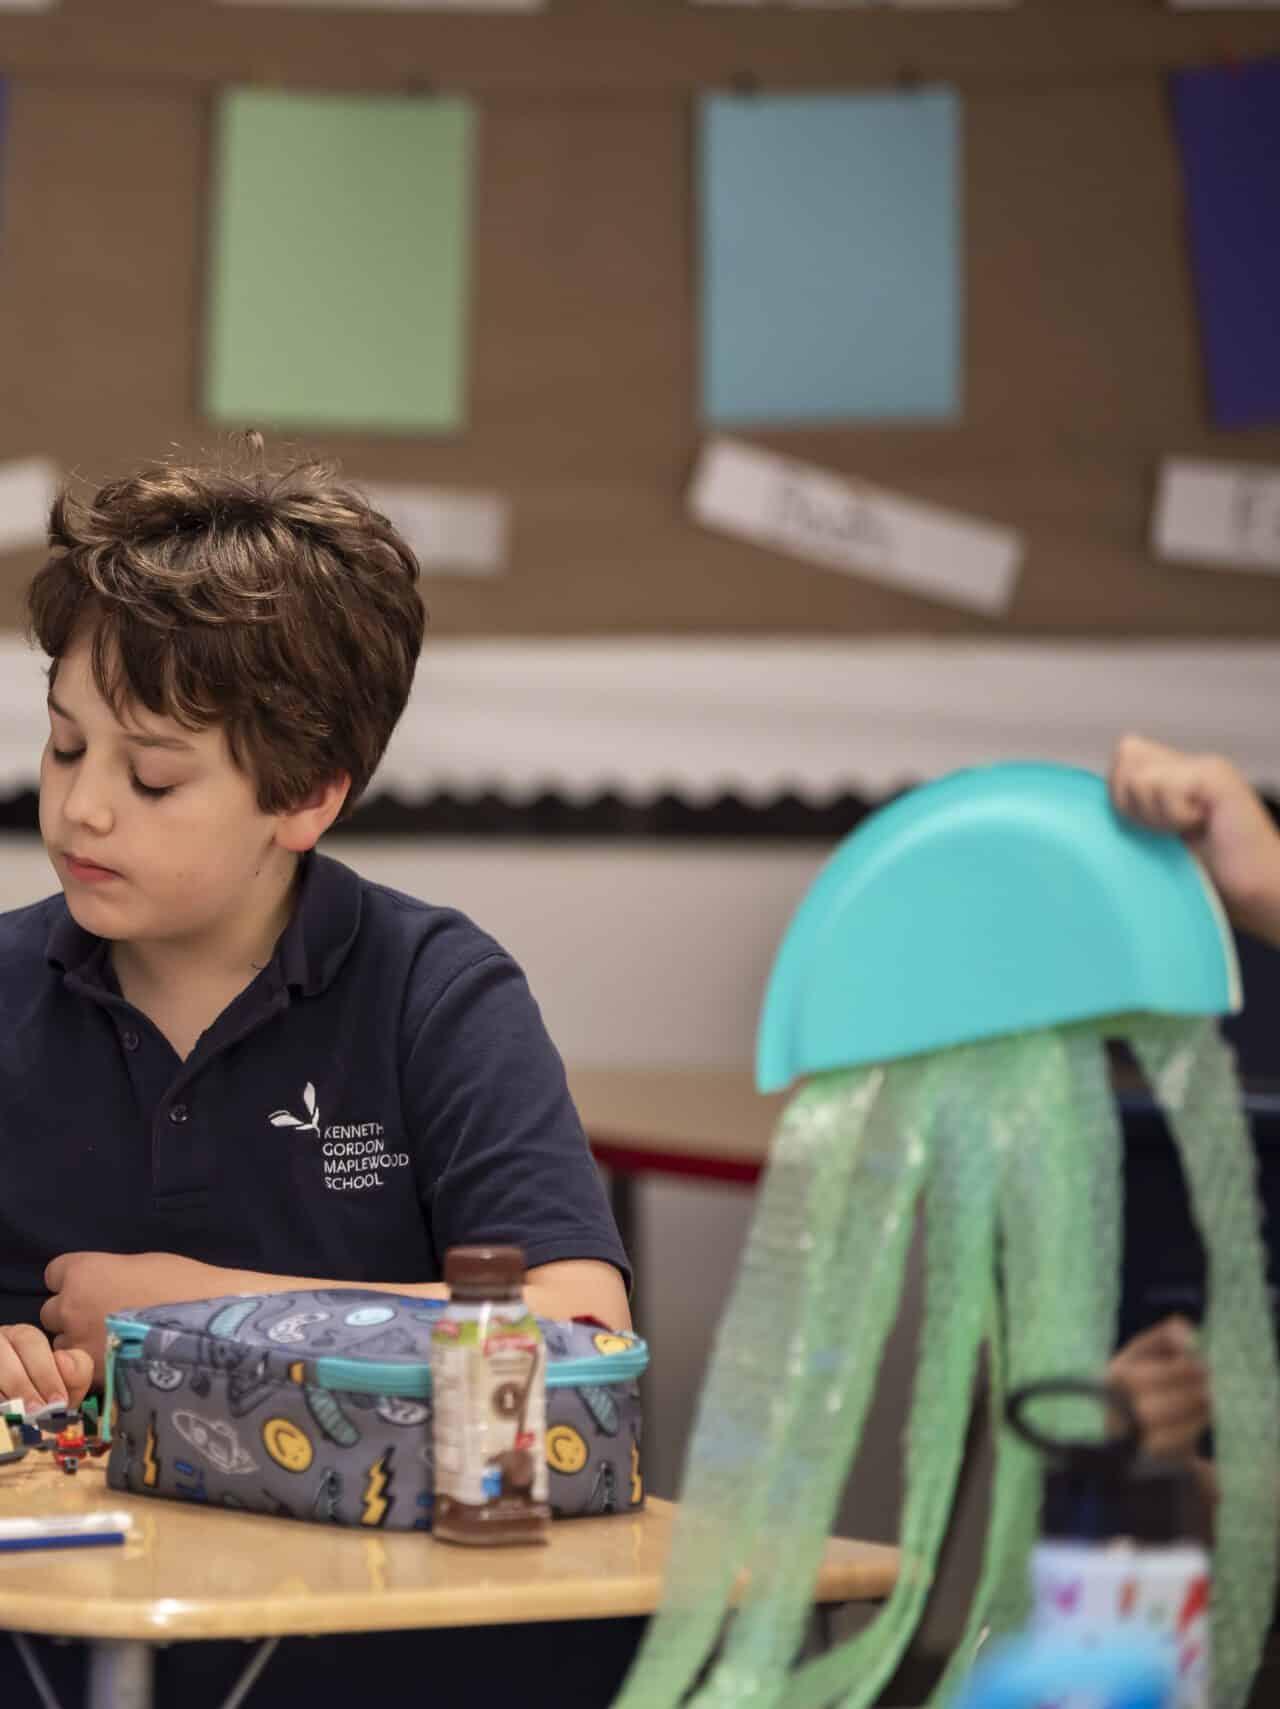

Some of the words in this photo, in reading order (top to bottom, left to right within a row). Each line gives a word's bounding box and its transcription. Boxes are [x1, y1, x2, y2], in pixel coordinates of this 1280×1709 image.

[324, 1122, 384, 1139] KENNETH
[322, 1139, 384, 1156] GORDON
[323, 1153, 409, 1174] MAPLEWOOD
[324, 1172, 384, 1190] SCHOOL
